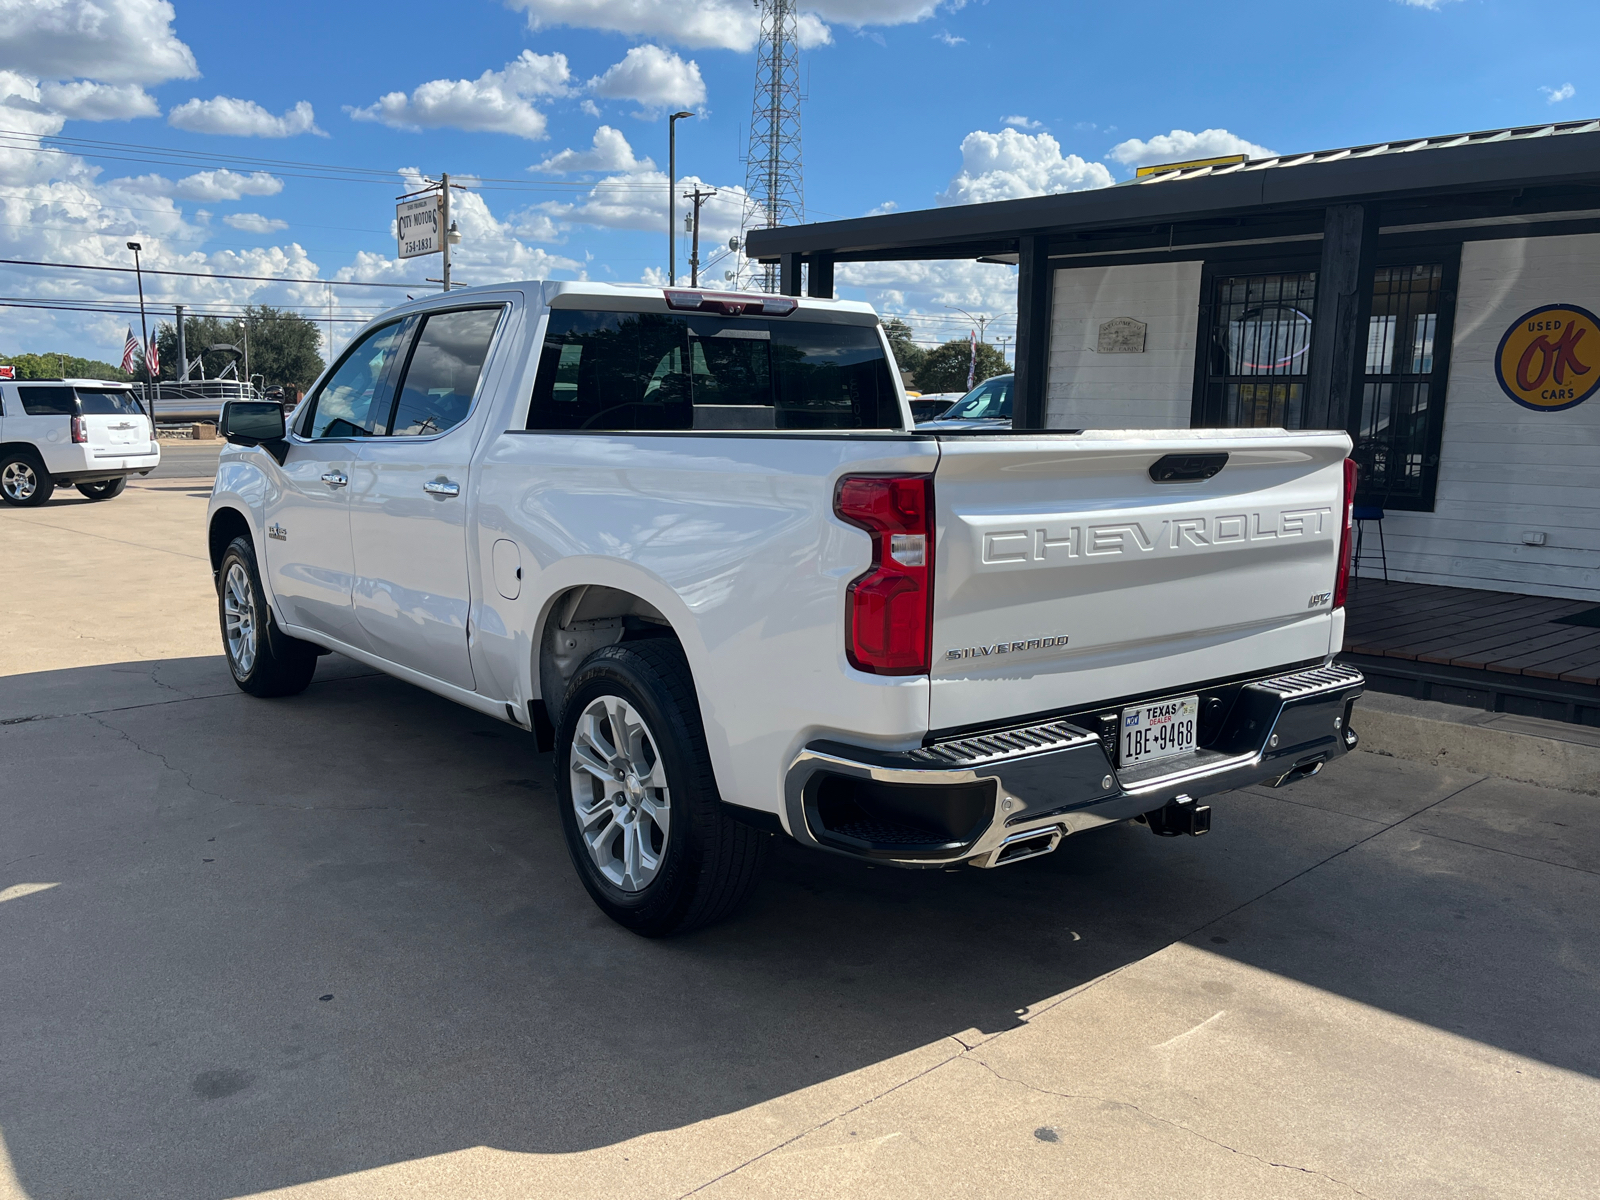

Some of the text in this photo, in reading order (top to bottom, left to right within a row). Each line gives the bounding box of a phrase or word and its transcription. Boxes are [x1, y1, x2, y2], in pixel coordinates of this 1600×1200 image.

[398, 208, 438, 241] CITY MOTORS
[405, 237, 432, 254] 754-1831
[1102, 320, 1132, 332] WELCOME
[1528, 320, 1561, 332] USED
[1516, 320, 1591, 392] OK
[1541, 388, 1574, 400] CARS
[982, 507, 1332, 565] CHEVROLET
[945, 634, 1069, 660] SILVERADO
[1146, 703, 1177, 720] TEXAS
[1126, 716, 1138, 725] NOV
[1149, 715, 1172, 726] DEALER
